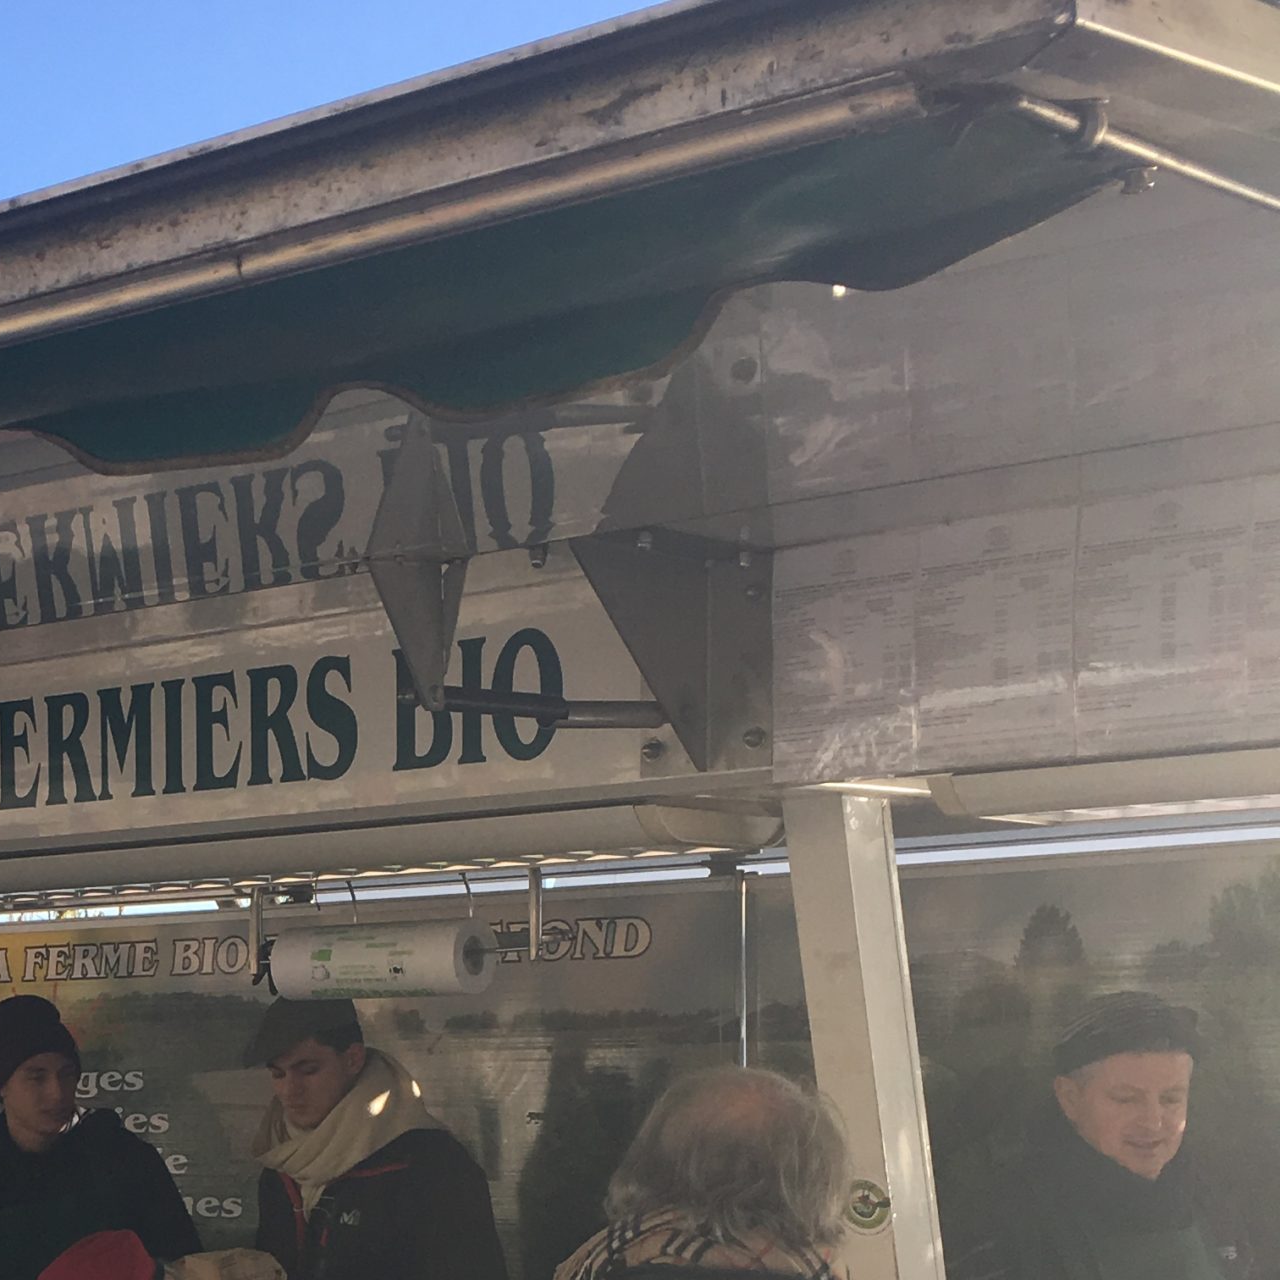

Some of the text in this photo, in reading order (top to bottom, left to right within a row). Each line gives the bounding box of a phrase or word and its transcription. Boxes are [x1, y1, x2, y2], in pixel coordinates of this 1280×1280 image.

[393, 627, 564, 772] BIO
[22, 939, 160, 983] FERME
[170, 936, 252, 977] BIO
